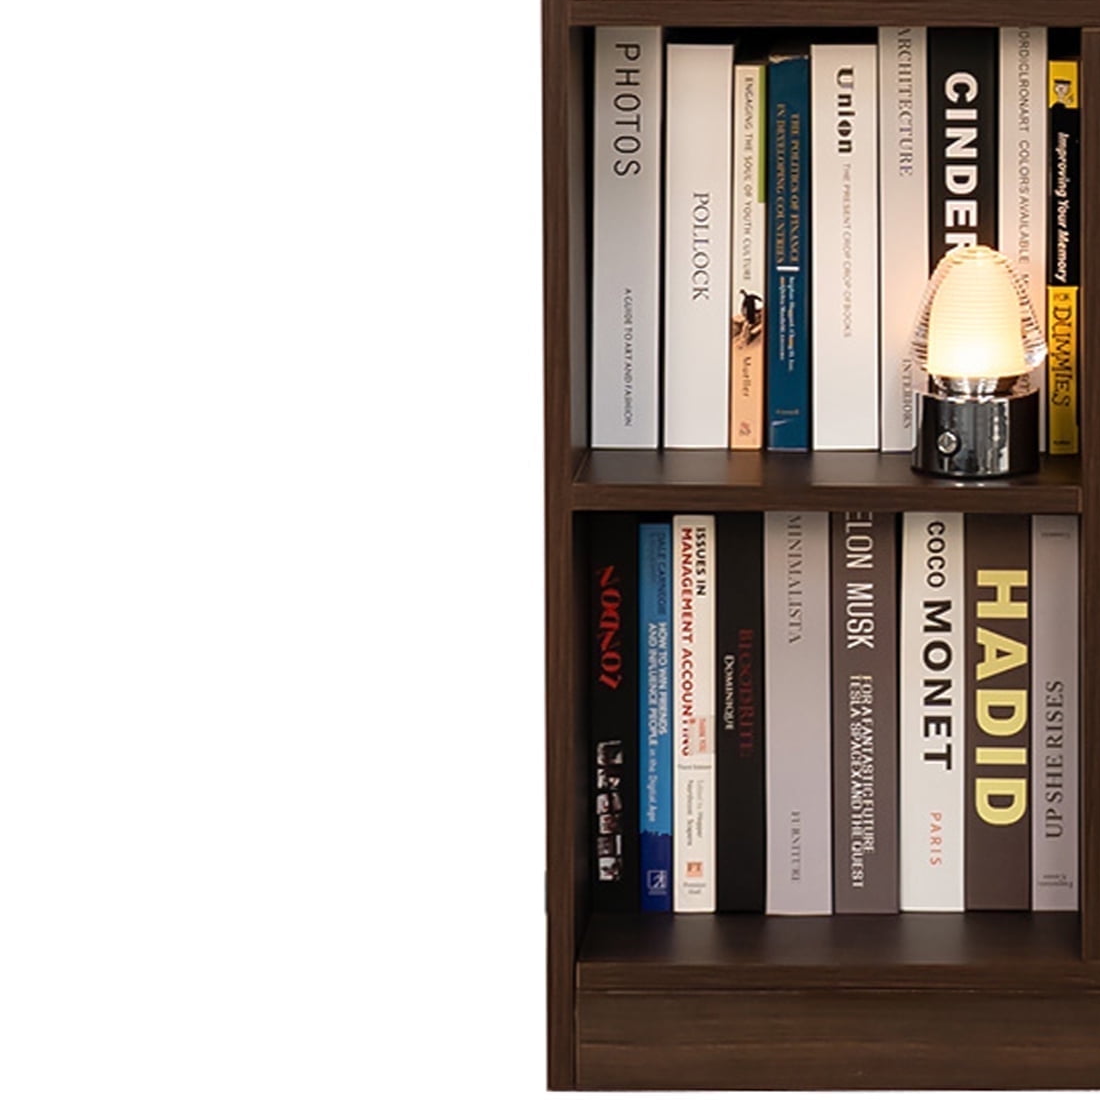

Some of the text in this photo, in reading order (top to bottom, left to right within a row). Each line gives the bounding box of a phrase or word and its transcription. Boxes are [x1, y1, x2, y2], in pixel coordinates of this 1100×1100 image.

[613, 43, 641, 177] PHOTOS
[897, 27, 913, 177] ARCHITECTURE
[742, 77, 754, 281] ENGAGING THE SOUL OF YOUTH CULTURE
[944, 72, 979, 252] CINDER
[1018, 139, 1030, 194] COLORS
[1018, 196, 1030, 262] AVAILABLE
[1054, 132, 1070, 283] Improving Your Memory
[692, 192, 710, 301] POLLOCK
[624, 296, 632, 326] GUIDE
[624, 327, 632, 341] TO
[624, 341, 632, 362] ART
[624, 362, 632, 383] AND
[1051, 305, 1072, 407] DUMMIES
[902, 359, 913, 429] INTERIORS
[681, 528, 693, 643] MANAGEMENT
[695, 527, 706, 596] ISSUES IN
[788, 515, 802, 644] MINIMALISTA
[927, 520, 946, 588] COCO
[597, 565, 622, 690] LONDON
[648, 623, 658, 647] AND
[846, 583, 875, 650] MUSK
[648, 648, 658, 706] INFLUENCE
[658, 622, 668, 735] HOW TO WIN FRIENDS
[723, 655, 735, 730] DOMINIQUE
[923, 600, 952, 770] MONET
[975, 569, 1028, 826] HADID
[648, 707, 658, 746] PEOPLE
[646, 775, 658, 804] Digital
[646, 805, 657, 822] Age
[930, 811, 942, 866] PARIS
